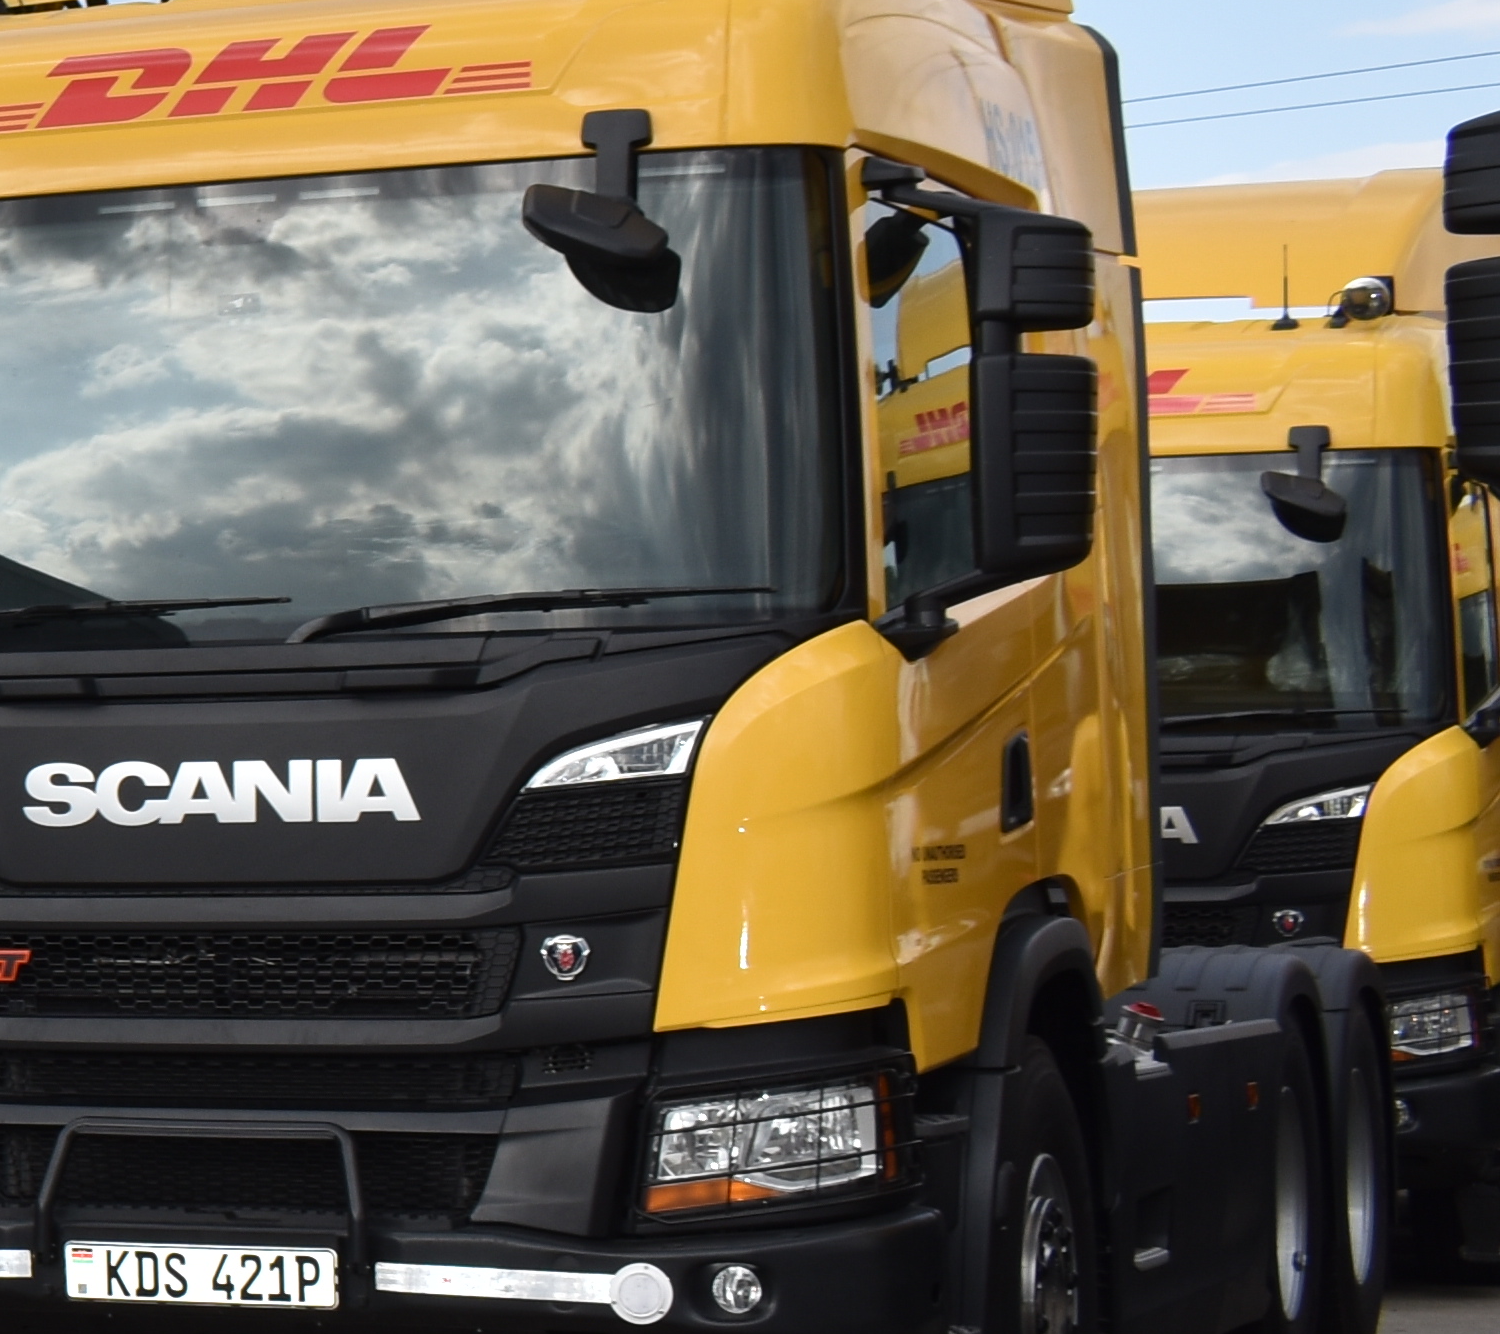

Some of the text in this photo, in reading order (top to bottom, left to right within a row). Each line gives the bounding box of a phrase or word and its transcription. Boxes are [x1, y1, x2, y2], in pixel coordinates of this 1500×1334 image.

[34, 24, 454, 129] DHL
[22, 757, 422, 828] SCANIA
[106, 1250, 321, 1302] KDS 421P
